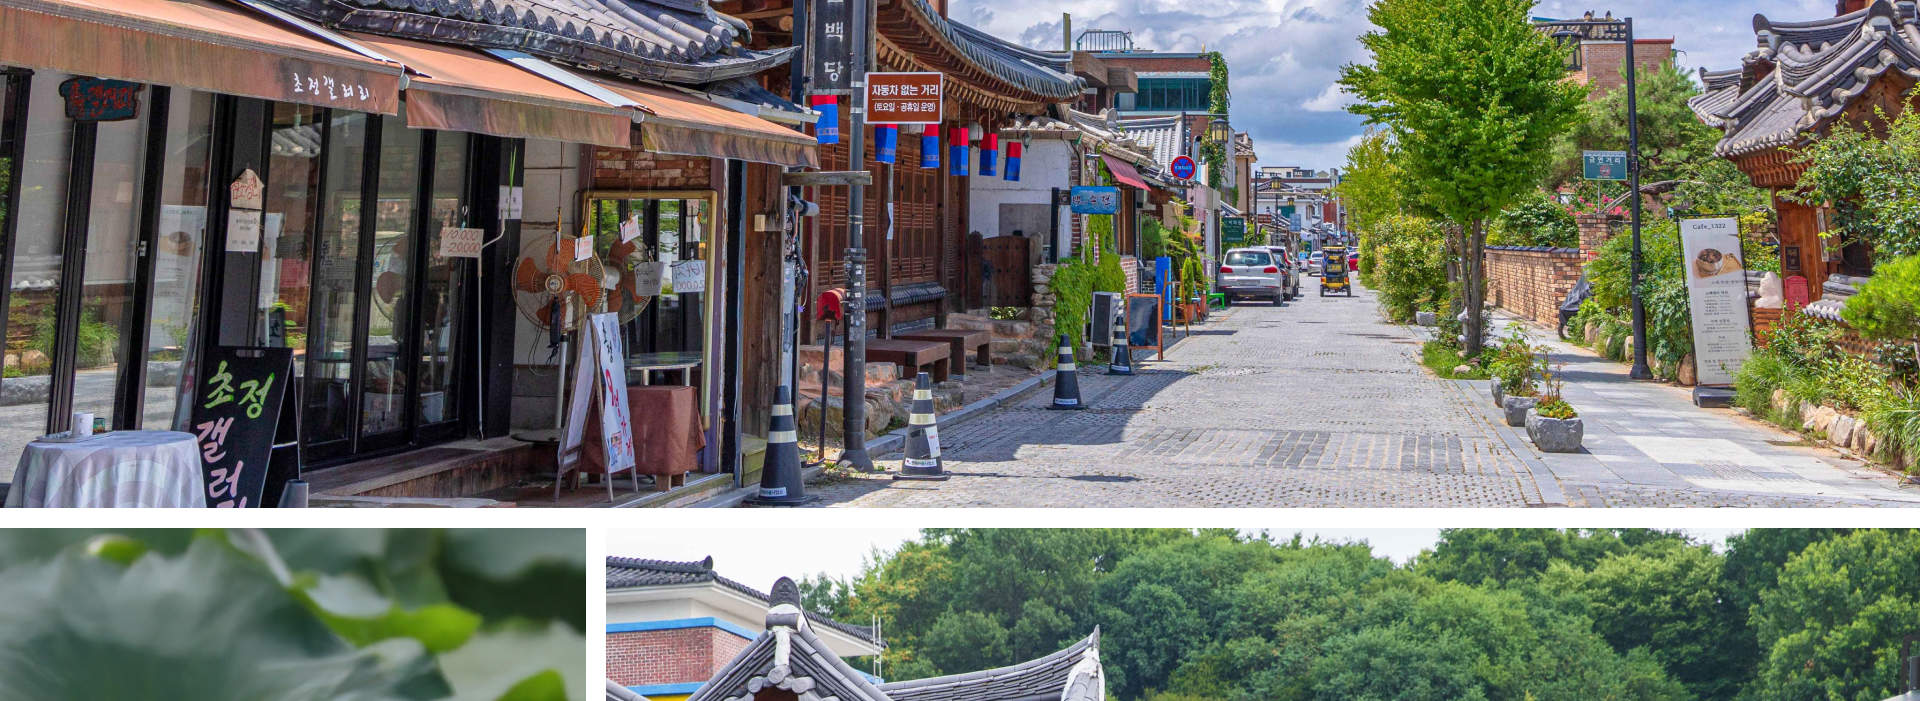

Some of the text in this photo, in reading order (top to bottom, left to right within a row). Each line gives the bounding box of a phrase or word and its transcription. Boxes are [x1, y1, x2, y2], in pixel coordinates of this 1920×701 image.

[824, 0, 844, 82] 백당
[871, 84, 939, 96] 자동차 없는 거리
[874, 102, 936, 112] (토요일 공휴일 운영)
[204, 360, 275, 419] 초정
